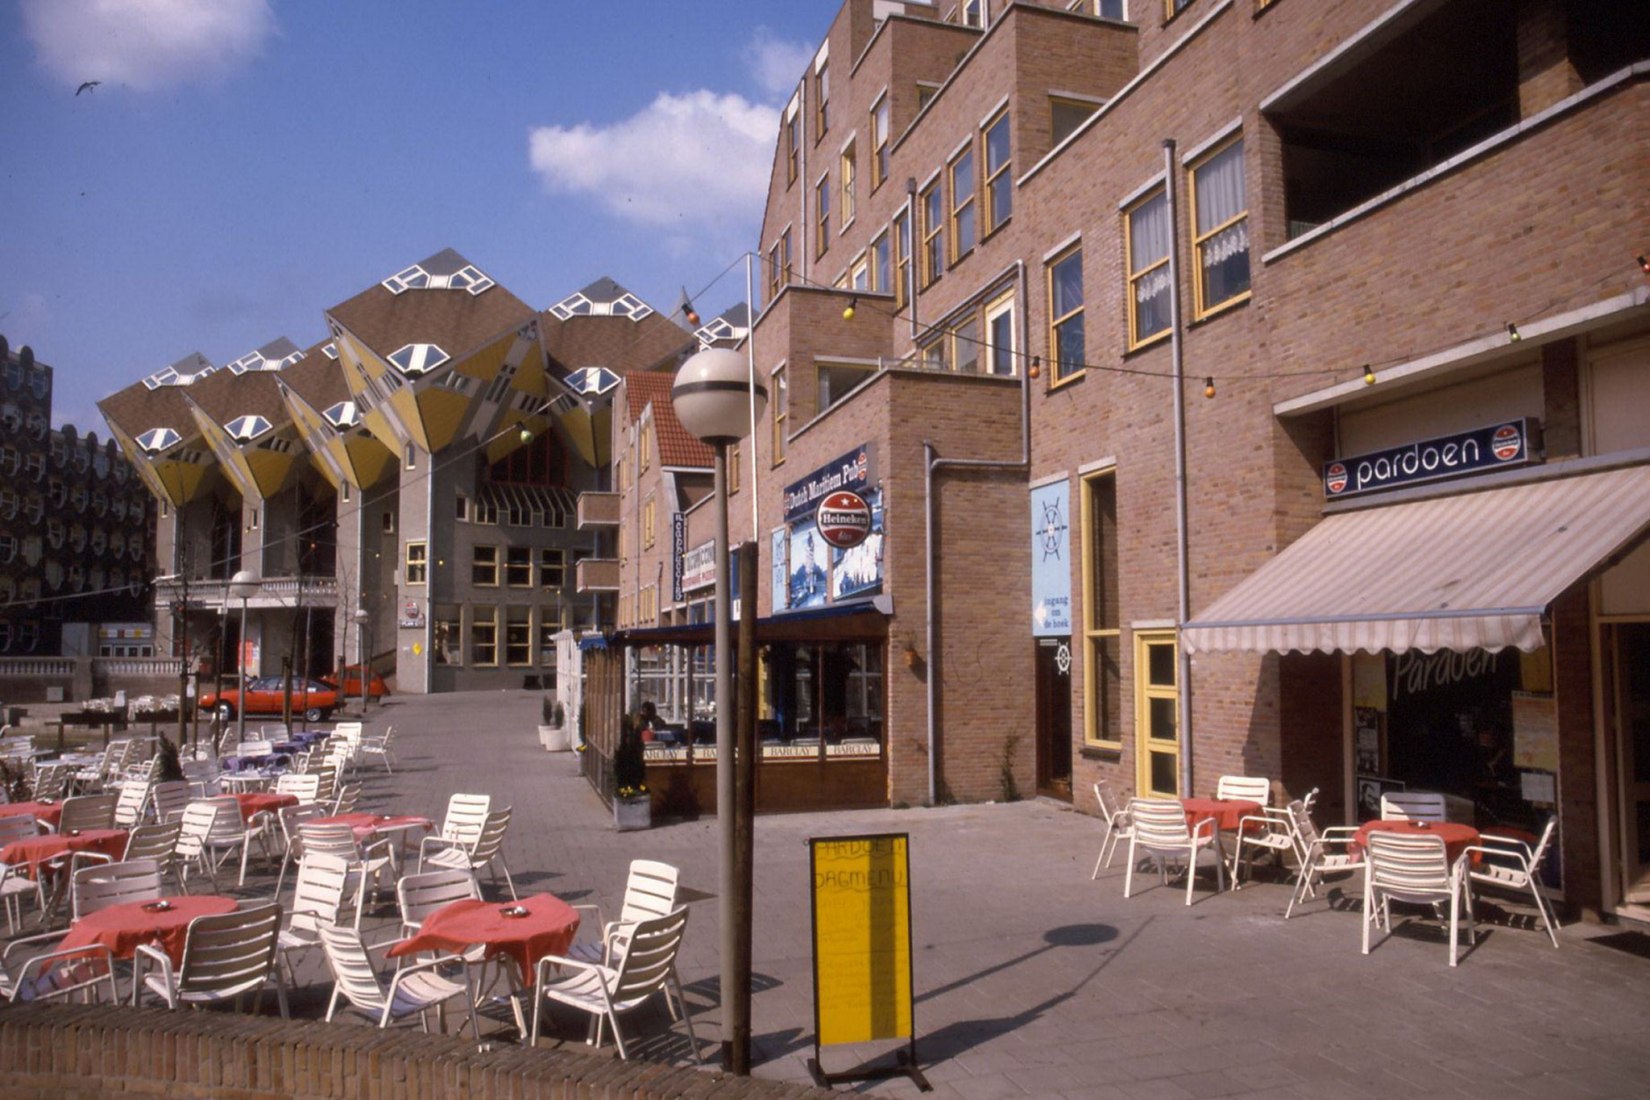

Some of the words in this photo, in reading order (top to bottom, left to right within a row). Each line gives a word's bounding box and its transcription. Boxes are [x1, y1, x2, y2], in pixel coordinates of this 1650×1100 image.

[1357, 438, 1480, 490] pardoen
[789, 486, 808, 510] Dutch
[808, 473, 842, 501] Maritiem
[842, 459, 859, 485] Pub
[823, 513, 867, 524] Heineken
[771, 746, 811, 757] BARCLAY
[834, 744, 873, 755] BARCLAY
